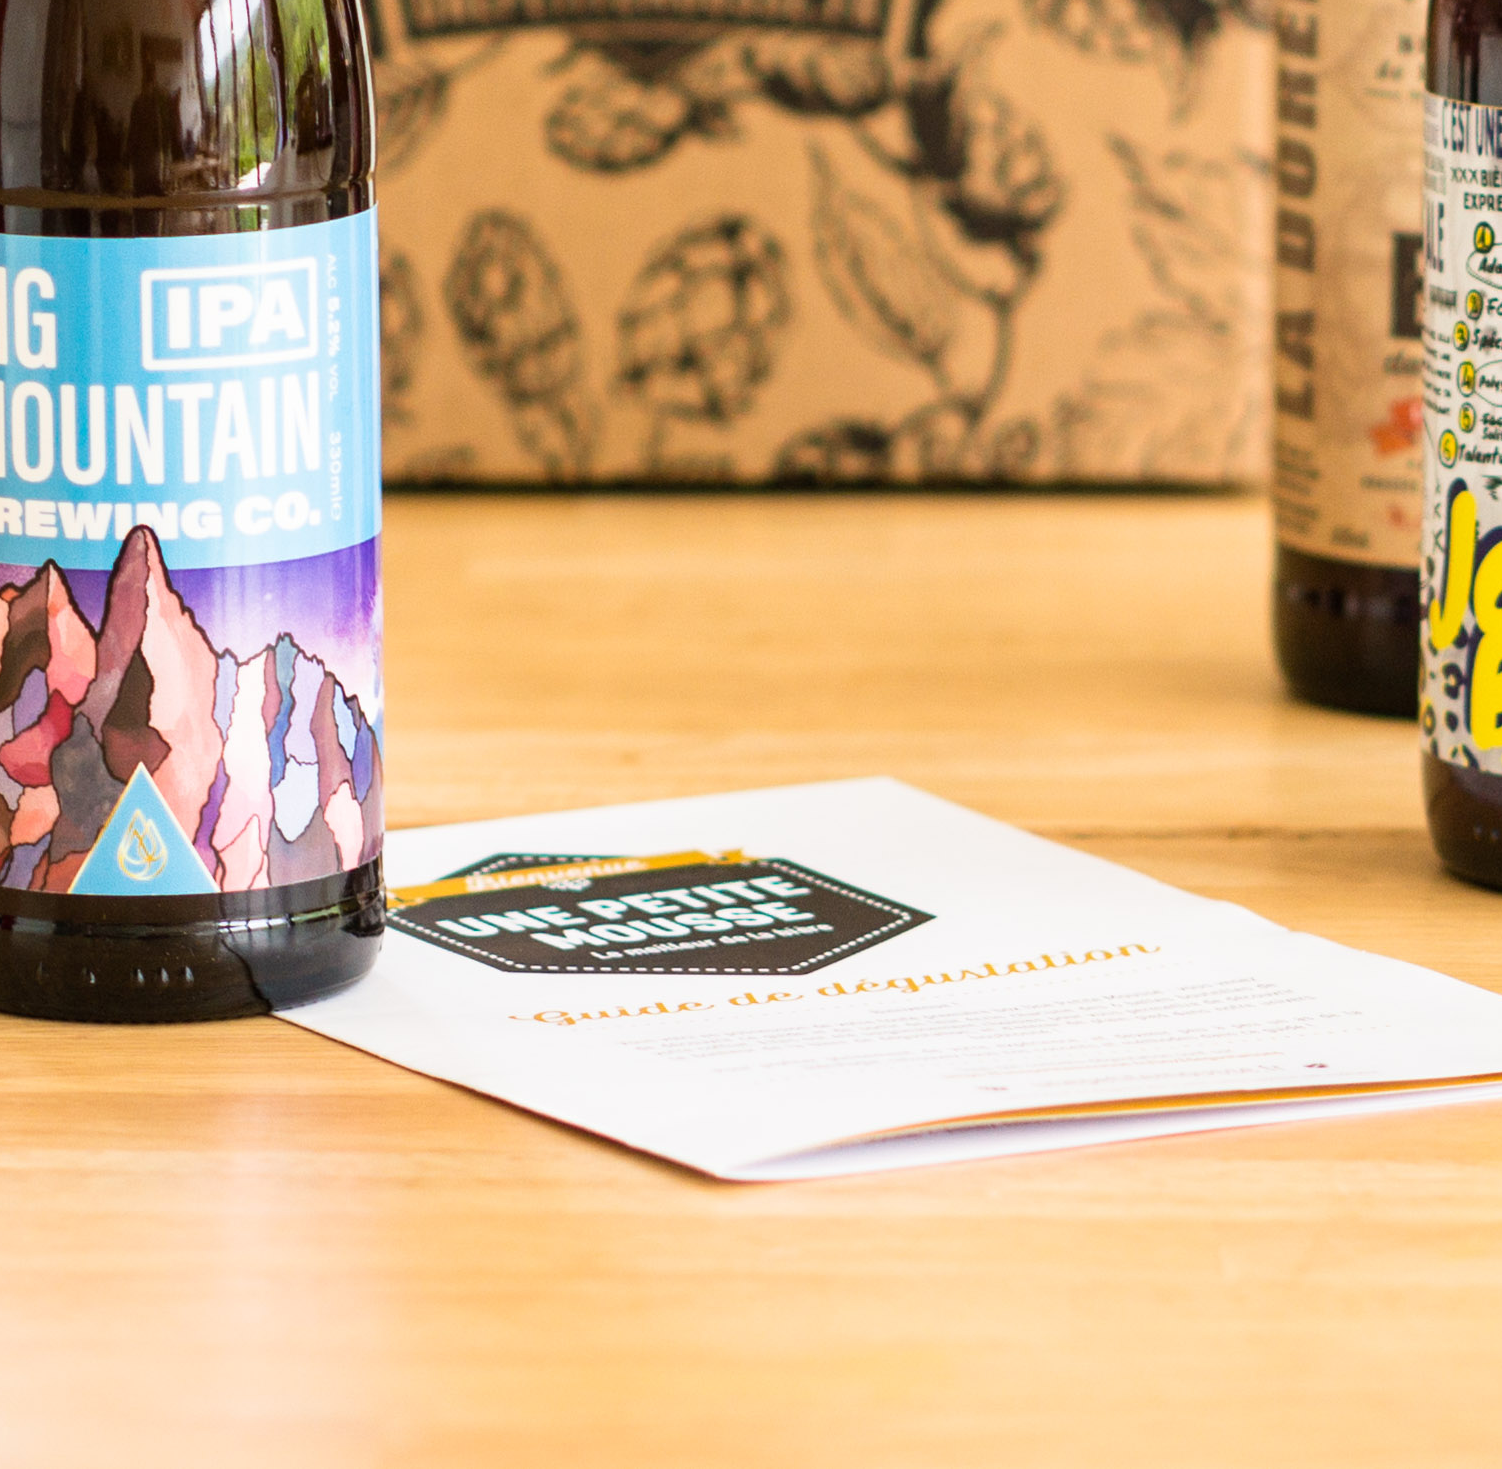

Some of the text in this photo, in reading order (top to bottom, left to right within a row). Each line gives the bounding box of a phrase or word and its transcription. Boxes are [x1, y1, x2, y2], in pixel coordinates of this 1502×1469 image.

[327, 254, 338, 290] ALC
[166, 277, 306, 350] IPA
[329, 364, 340, 403] VOL
[1275, 310, 1315, 421] LA
[234, 490, 322, 536] CO.
[436, 875, 814, 939] UNE PETITE
[530, 900, 817, 952] MOUSSE
[623, 937, 718, 958] meilleur
[718, 931, 751, 946] de
[770, 922, 835, 938] bière
[507, 940, 1163, 1028] Guide de dégustation
